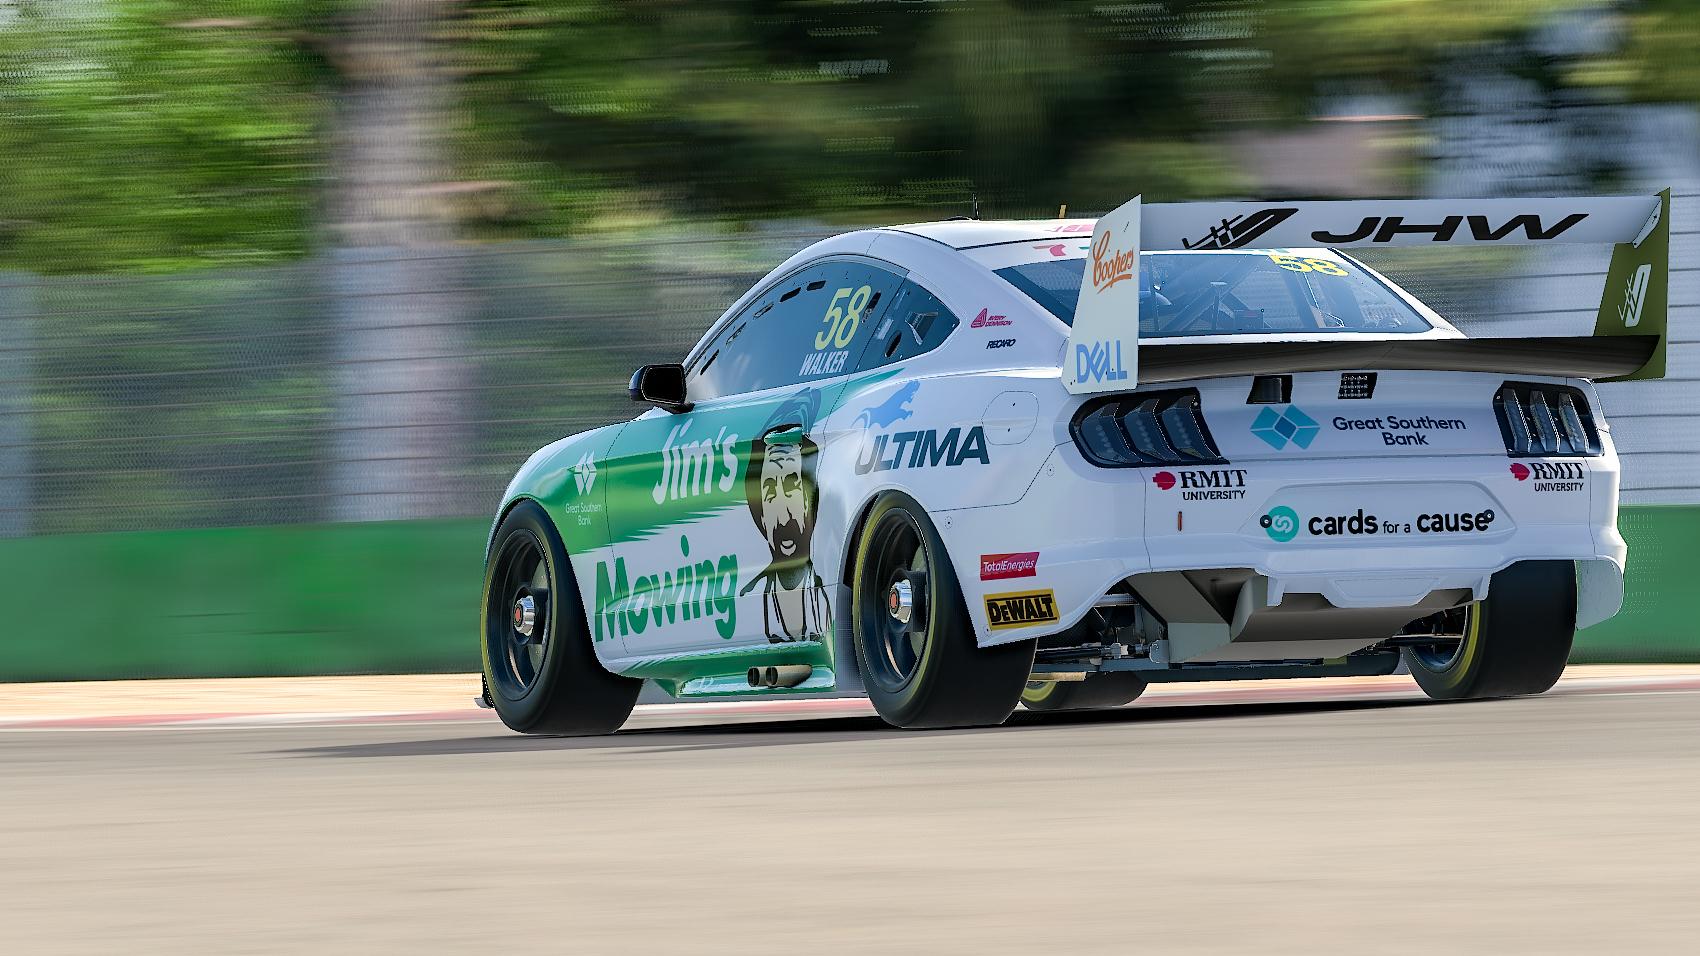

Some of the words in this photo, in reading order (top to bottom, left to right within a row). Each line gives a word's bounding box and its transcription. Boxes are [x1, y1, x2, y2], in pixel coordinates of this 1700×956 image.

[1310, 213, 1590, 243] JHW
[1092, 230, 1134, 289] Coopers
[1266, 254, 1350, 277] 58
[814, 285, 872, 351] 58
[986, 338, 1016, 350] RECARO
[799, 350, 849, 376] WALKER
[1076, 340, 1127, 384] DELL
[1332, 415, 1385, 431] Great
[1386, 415, 1467, 431] Southern
[1381, 431, 1429, 446] Bank
[854, 425, 990, 475] ULTIMA
[652, 418, 739, 505] Jim's
[1528, 462, 1585, 480] RMIT
[1178, 469, 1248, 489] RMIT
[1534, 482, 1584, 492] UNIVERSITY
[1182, 490, 1246, 501] UNIVERSITY
[565, 503, 580, 514] Great
[577, 514, 592, 526] Bank
[1308, 509, 1379, 536] cards
[1383, 520, 1400, 534] for
[1403, 524, 1411, 534] a
[1416, 512, 1489, 532] cause
[983, 558, 1035, 573] TotalEnergies
[594, 534, 739, 643] Mowing
